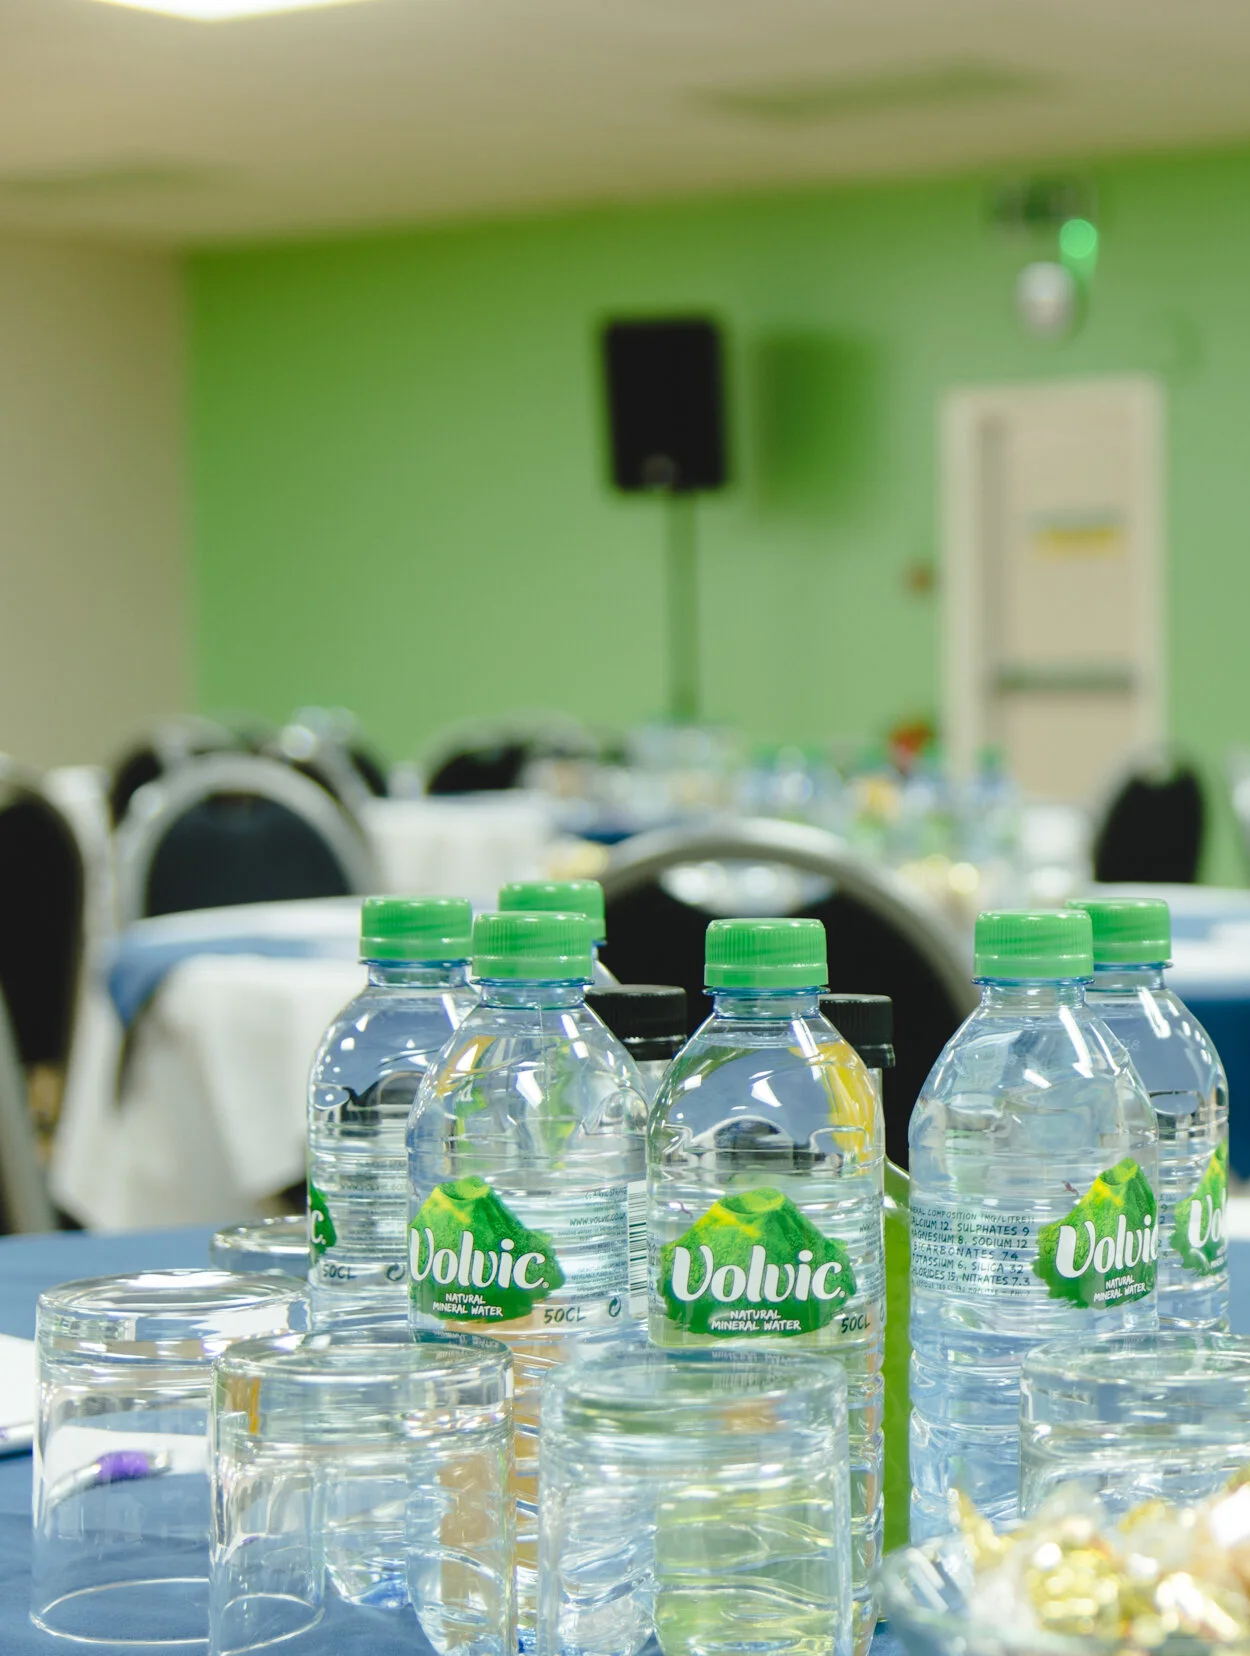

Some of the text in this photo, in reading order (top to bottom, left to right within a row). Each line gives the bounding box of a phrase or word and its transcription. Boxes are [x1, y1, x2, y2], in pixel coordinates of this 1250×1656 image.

[928, 1209, 977, 1221] COMPOSITION
[957, 1223, 1018, 1236] SULPHATES
[1022, 1227, 1030, 1237] 9
[972, 1237, 1012, 1249] SODIUM
[1017, 1240, 1028, 1249] 12
[408, 1227, 549, 1290] Volvic
[1002, 1252, 1019, 1262] 74
[671, 1244, 846, 1303] Volvic
[971, 1262, 1004, 1274] SILICA
[1010, 1264, 1024, 1275] 32
[962, 1272, 1009, 1286] NITRATES
[1012, 1277, 1031, 1287] 7.3
[1105, 1275, 1135, 1289] NATURAL
[445, 1293, 487, 1305] NATURAL
[1093, 1282, 1147, 1303] MINERAL WATER
[432, 1301, 504, 1318] MINERAL WATER
[544, 1306, 587, 1325] 50CL
[730, 1309, 782, 1320] NATURAL
[711, 1319, 802, 1332] MINERAL WATER
[840, 1316, 872, 1335] 50CL
